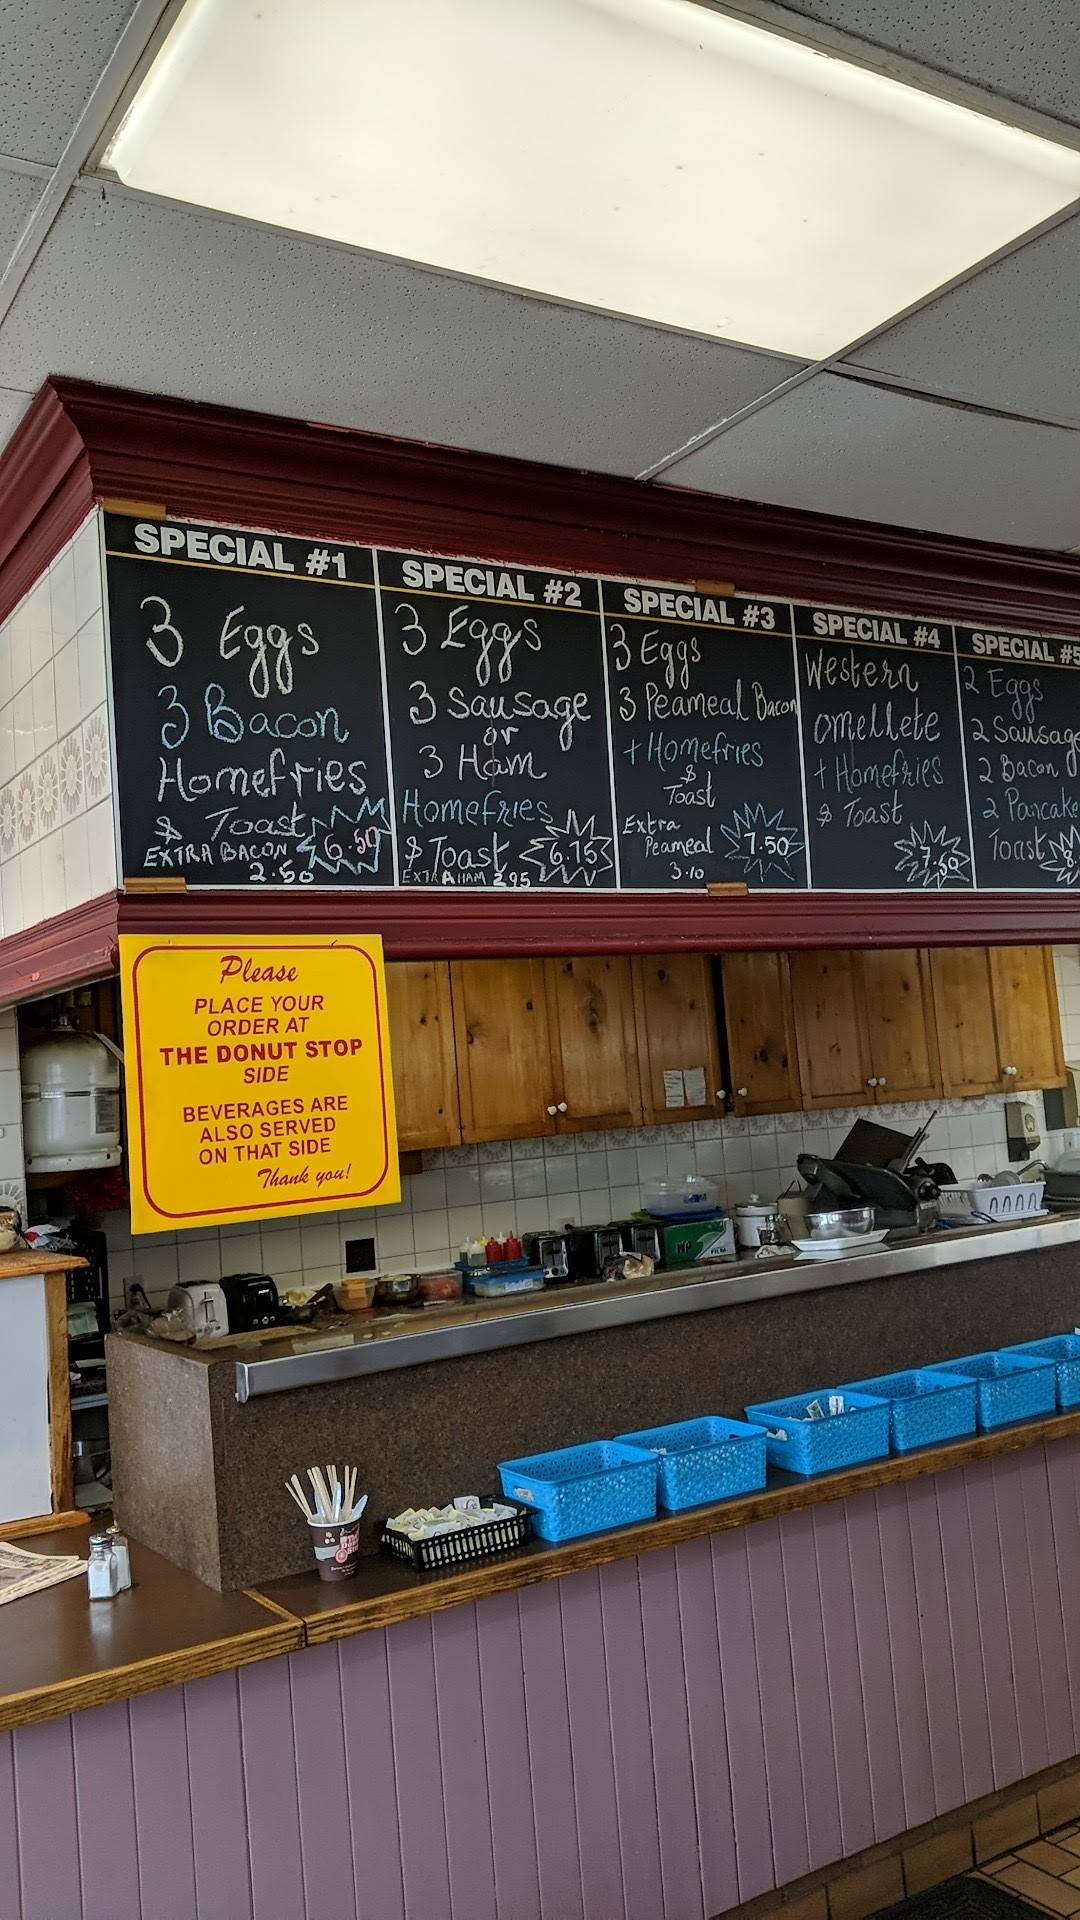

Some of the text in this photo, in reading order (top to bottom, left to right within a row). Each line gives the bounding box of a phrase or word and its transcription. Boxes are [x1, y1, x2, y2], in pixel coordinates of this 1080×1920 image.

[134, 524, 347, 578] SPECIAL #1
[402, 560, 582, 607] SPECIAL #2
[623, 588, 776, 630] SPECIAL #3
[140, 596, 319, 698] 3 Eggs
[394, 603, 541, 687] 3 Eggs
[813, 612, 941, 648] SPECIAL #4
[609, 623, 701, 690] 3 Eggs
[972, 633, 1080, 666] SPECIAL #5
[805, 648, 919, 692] Western
[619, 678, 799, 722] 3 Peameal Bacon
[963, 665, 1044, 724] 2 Eggs
[158, 683, 349, 749] 3 Bacon
[409, 680, 591, 751] 3 Sausage
[972, 718, 990, 743] 2
[483, 726, 520, 746] or
[158, 748, 367, 802] Homefries
[419, 744, 548, 781] 3 Ham
[836, 748, 944, 794] Homefries
[978, 754, 1058, 783] 2 Bacon
[663, 771, 717, 808] Toast
[205, 802, 305, 840] Toast
[402, 788, 554, 828] Homefries
[622, 811, 681, 836] Extra
[843, 789, 904, 828] Toast
[983, 797, 999, 819] 2
[143, 841, 287, 869] EXTRA BACON
[427, 832, 510, 873] Toast
[643, 826, 715, 858] Peameal
[988, 826, 1047, 861] Toast
[249, 862, 314, 883] 2.50
[402, 869, 456, 885] EXTRA
[457, 871, 487, 885] HAM
[669, 861, 705, 881] 3.10
[920, 846, 959, 876] 7.50
[220, 955, 298, 985] Please
[194, 995, 324, 1015] PLACE YOUR
[207, 1017, 310, 1037] ORDER AT
[160, 1039, 363, 1066] THE DONUT STOP
[243, 1066, 289, 1084] SIDE
[183, 1096, 348, 1123] BEVERAGES ARE
[200, 1117, 336, 1143] ALSO SERVED
[199, 1137, 331, 1165] ON THAT SIDE
[257, 1163, 352, 1189] Thank you!
